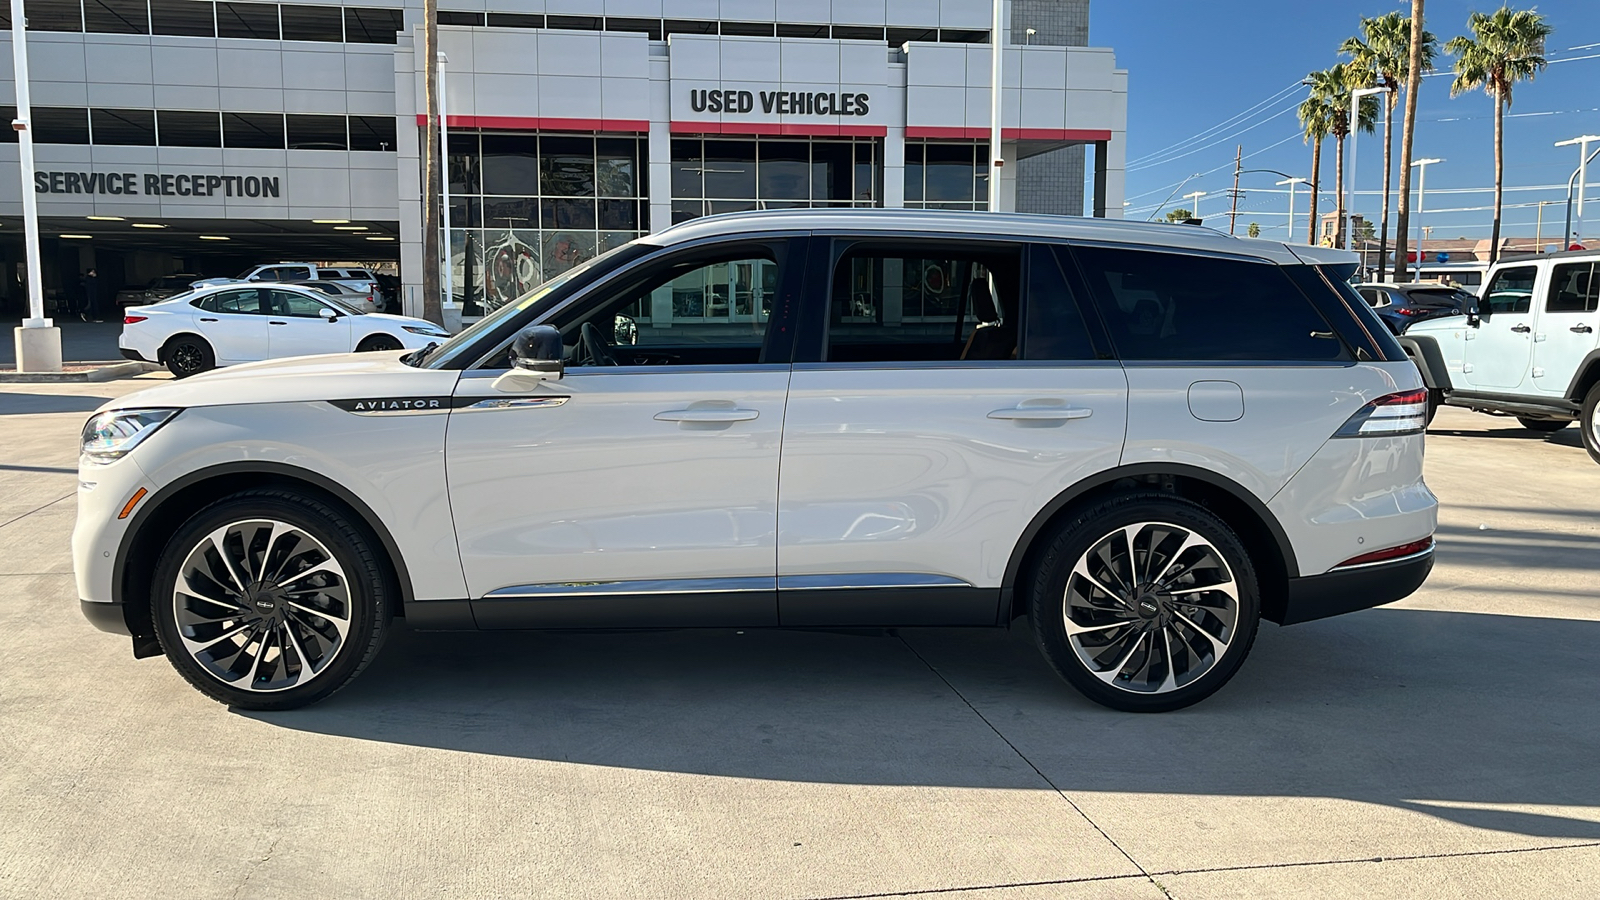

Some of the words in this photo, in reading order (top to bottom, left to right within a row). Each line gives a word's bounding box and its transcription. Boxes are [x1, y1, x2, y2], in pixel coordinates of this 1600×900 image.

[691, 89, 754, 114] USED
[760, 91, 870, 116] VEHICLES
[34, 171, 138, 195] SERVICE
[144, 173, 280, 198] RECEPTION
[355, 399, 440, 410] AVIATOR
